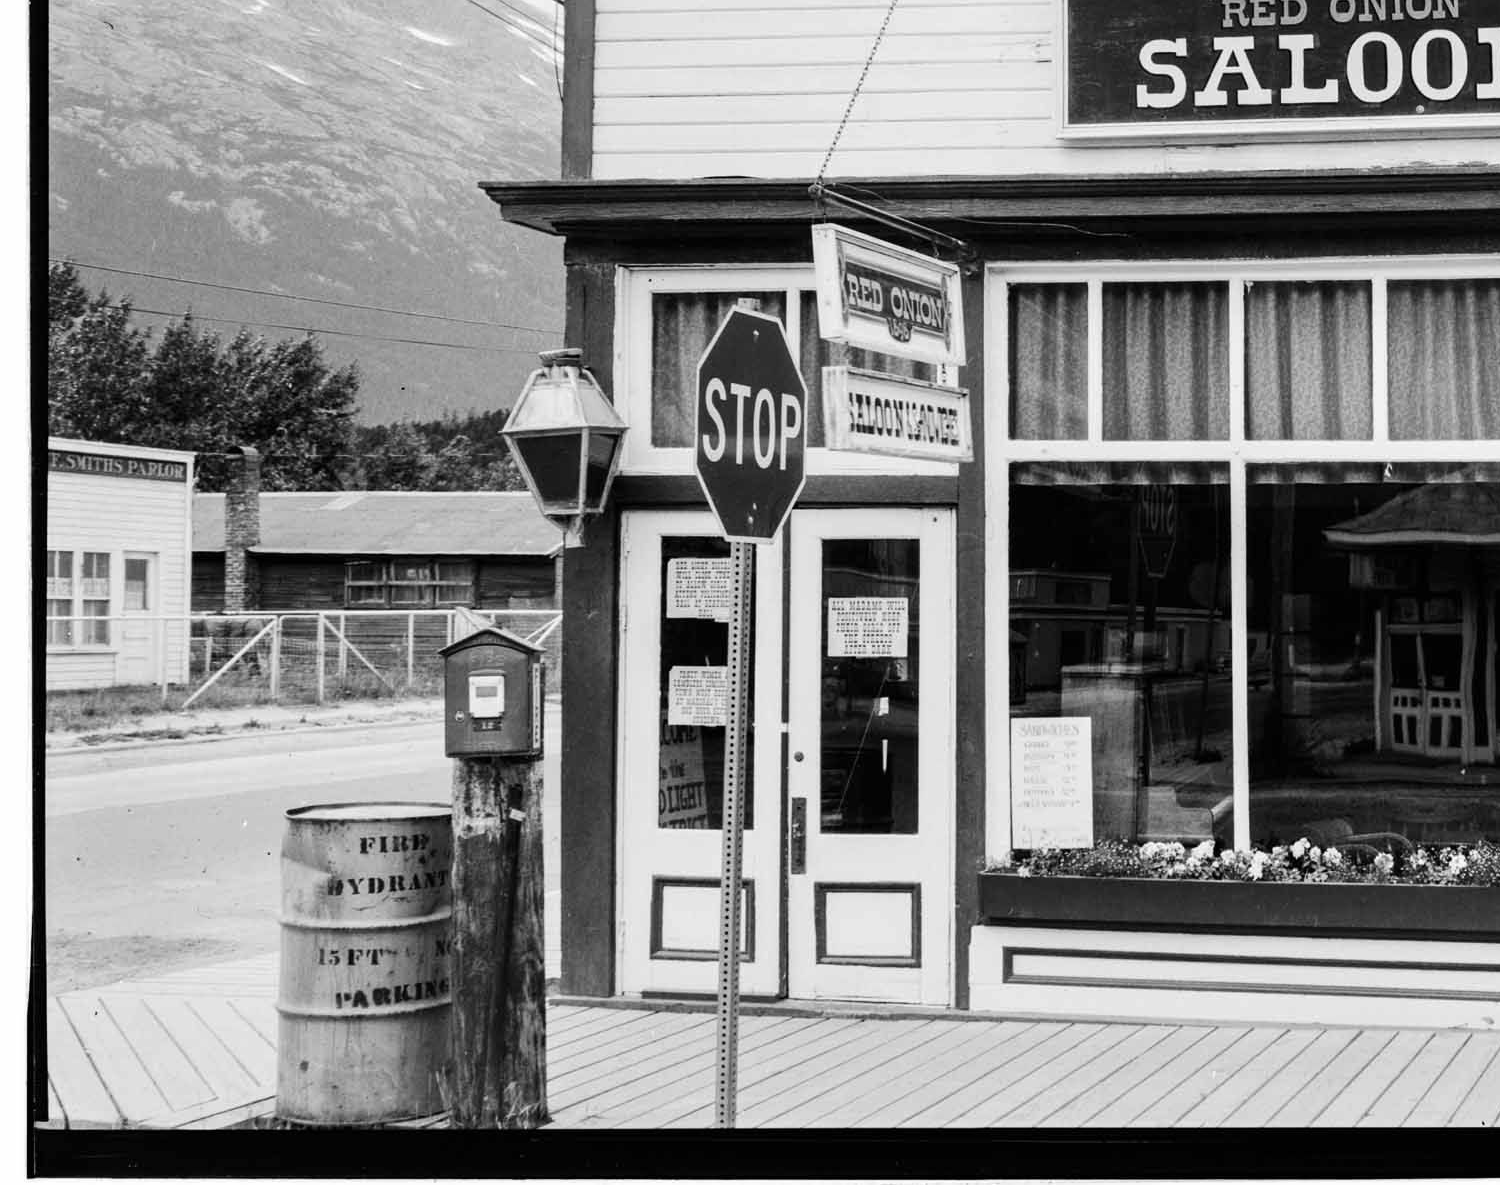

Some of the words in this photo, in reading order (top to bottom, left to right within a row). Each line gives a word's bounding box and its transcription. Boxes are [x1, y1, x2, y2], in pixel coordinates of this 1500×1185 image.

[846, 273, 883, 312] RED
[891, 286, 943, 329] ONION
[702, 377, 802, 471] STOP
[66, 453, 123, 474] SMITHS
[127, 459, 185, 479] PARLOR
[667, 781, 704, 813] LIGHT
[359, 833, 430, 854] FIRE
[335, 978, 450, 1009] PARKING
